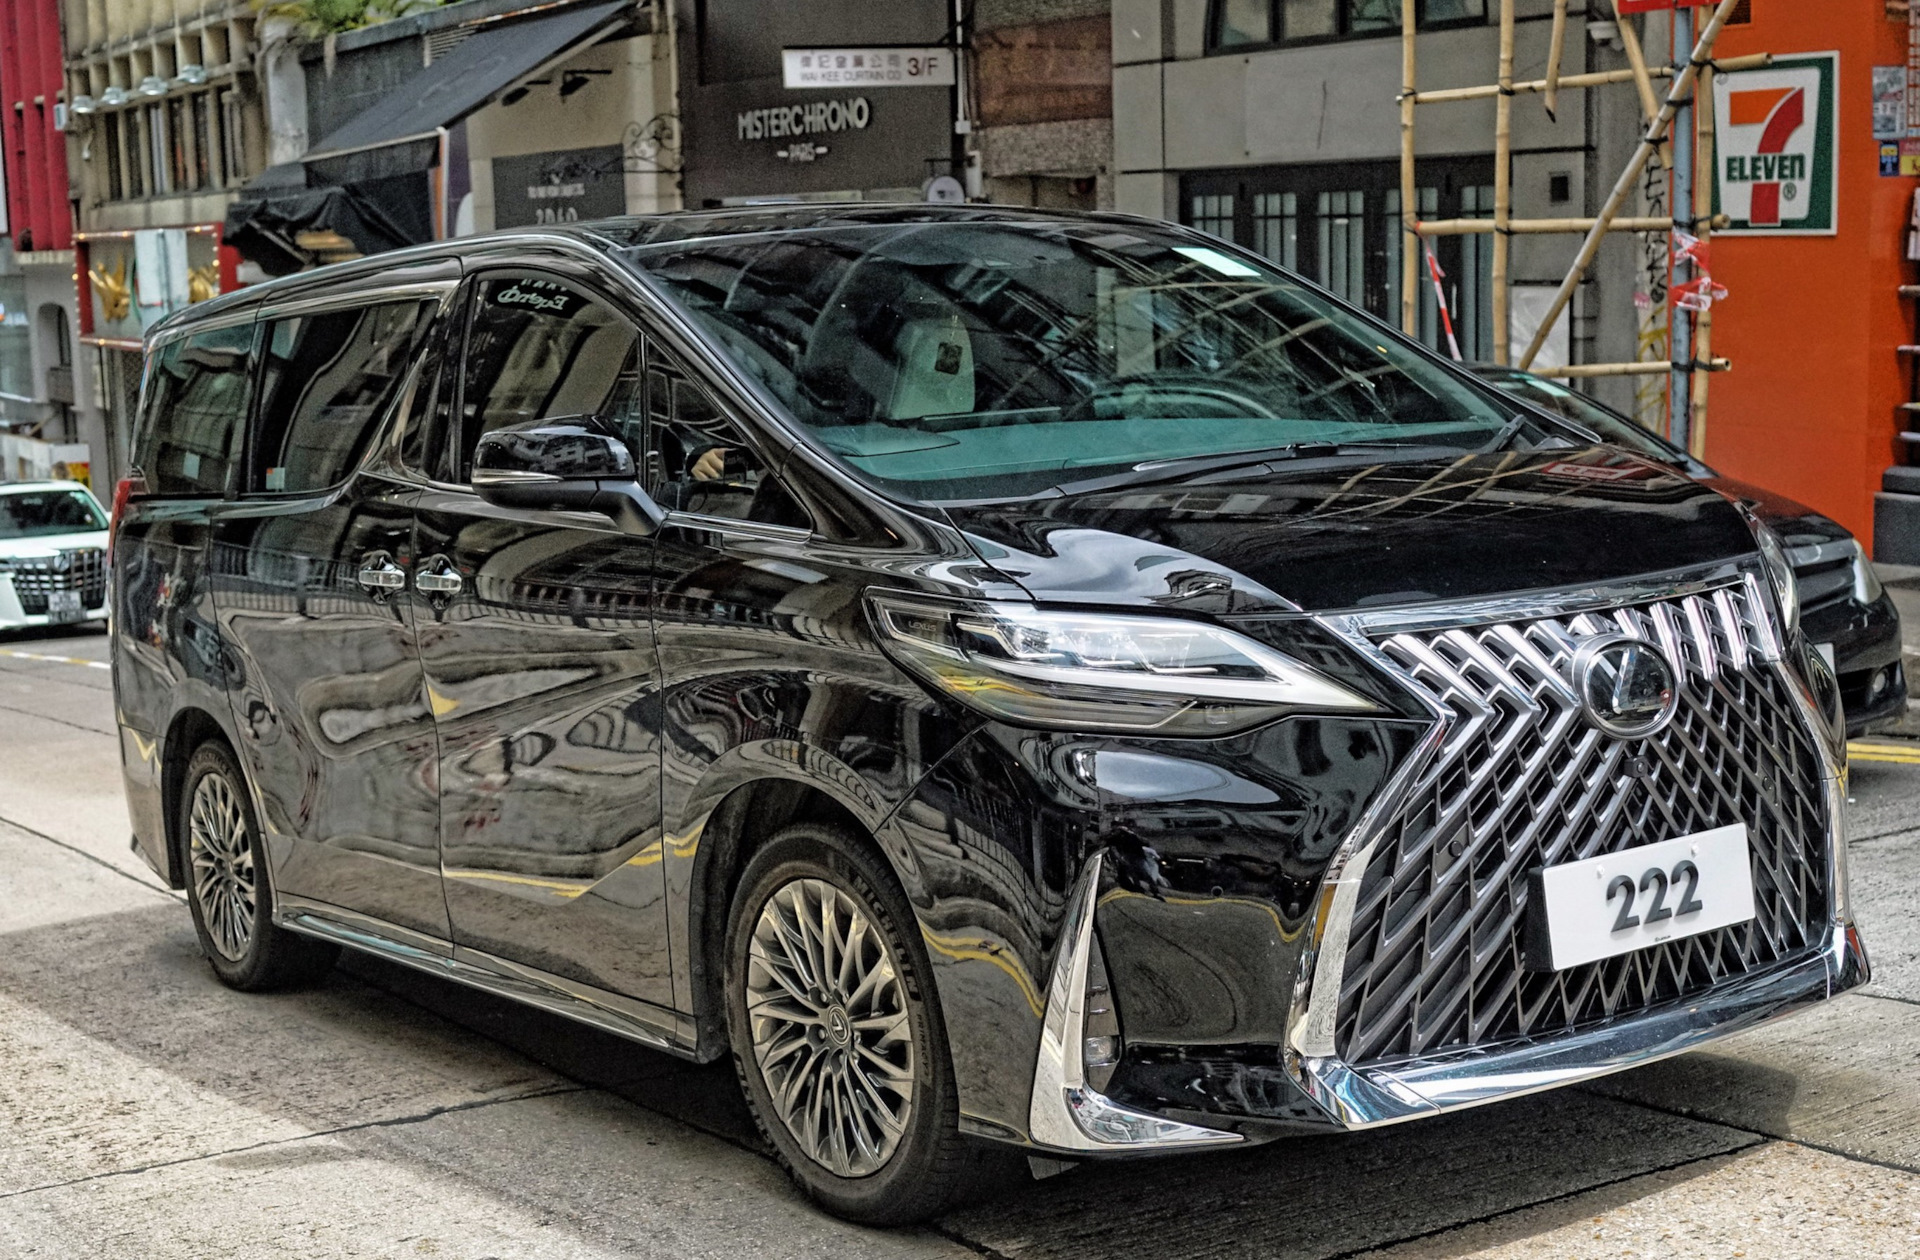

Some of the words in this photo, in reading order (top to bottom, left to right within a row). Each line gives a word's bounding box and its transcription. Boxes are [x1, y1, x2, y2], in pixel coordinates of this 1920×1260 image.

[907, 56, 938, 77] 3/F
[738, 97, 869, 140] MISTERCHRONO
[1729, 87, 1804, 224] 7
[908, 620, 937, 631] LEXUS
[1606, 859, 1703, 933] 222
[853, 876, 919, 993] MICHELIN
